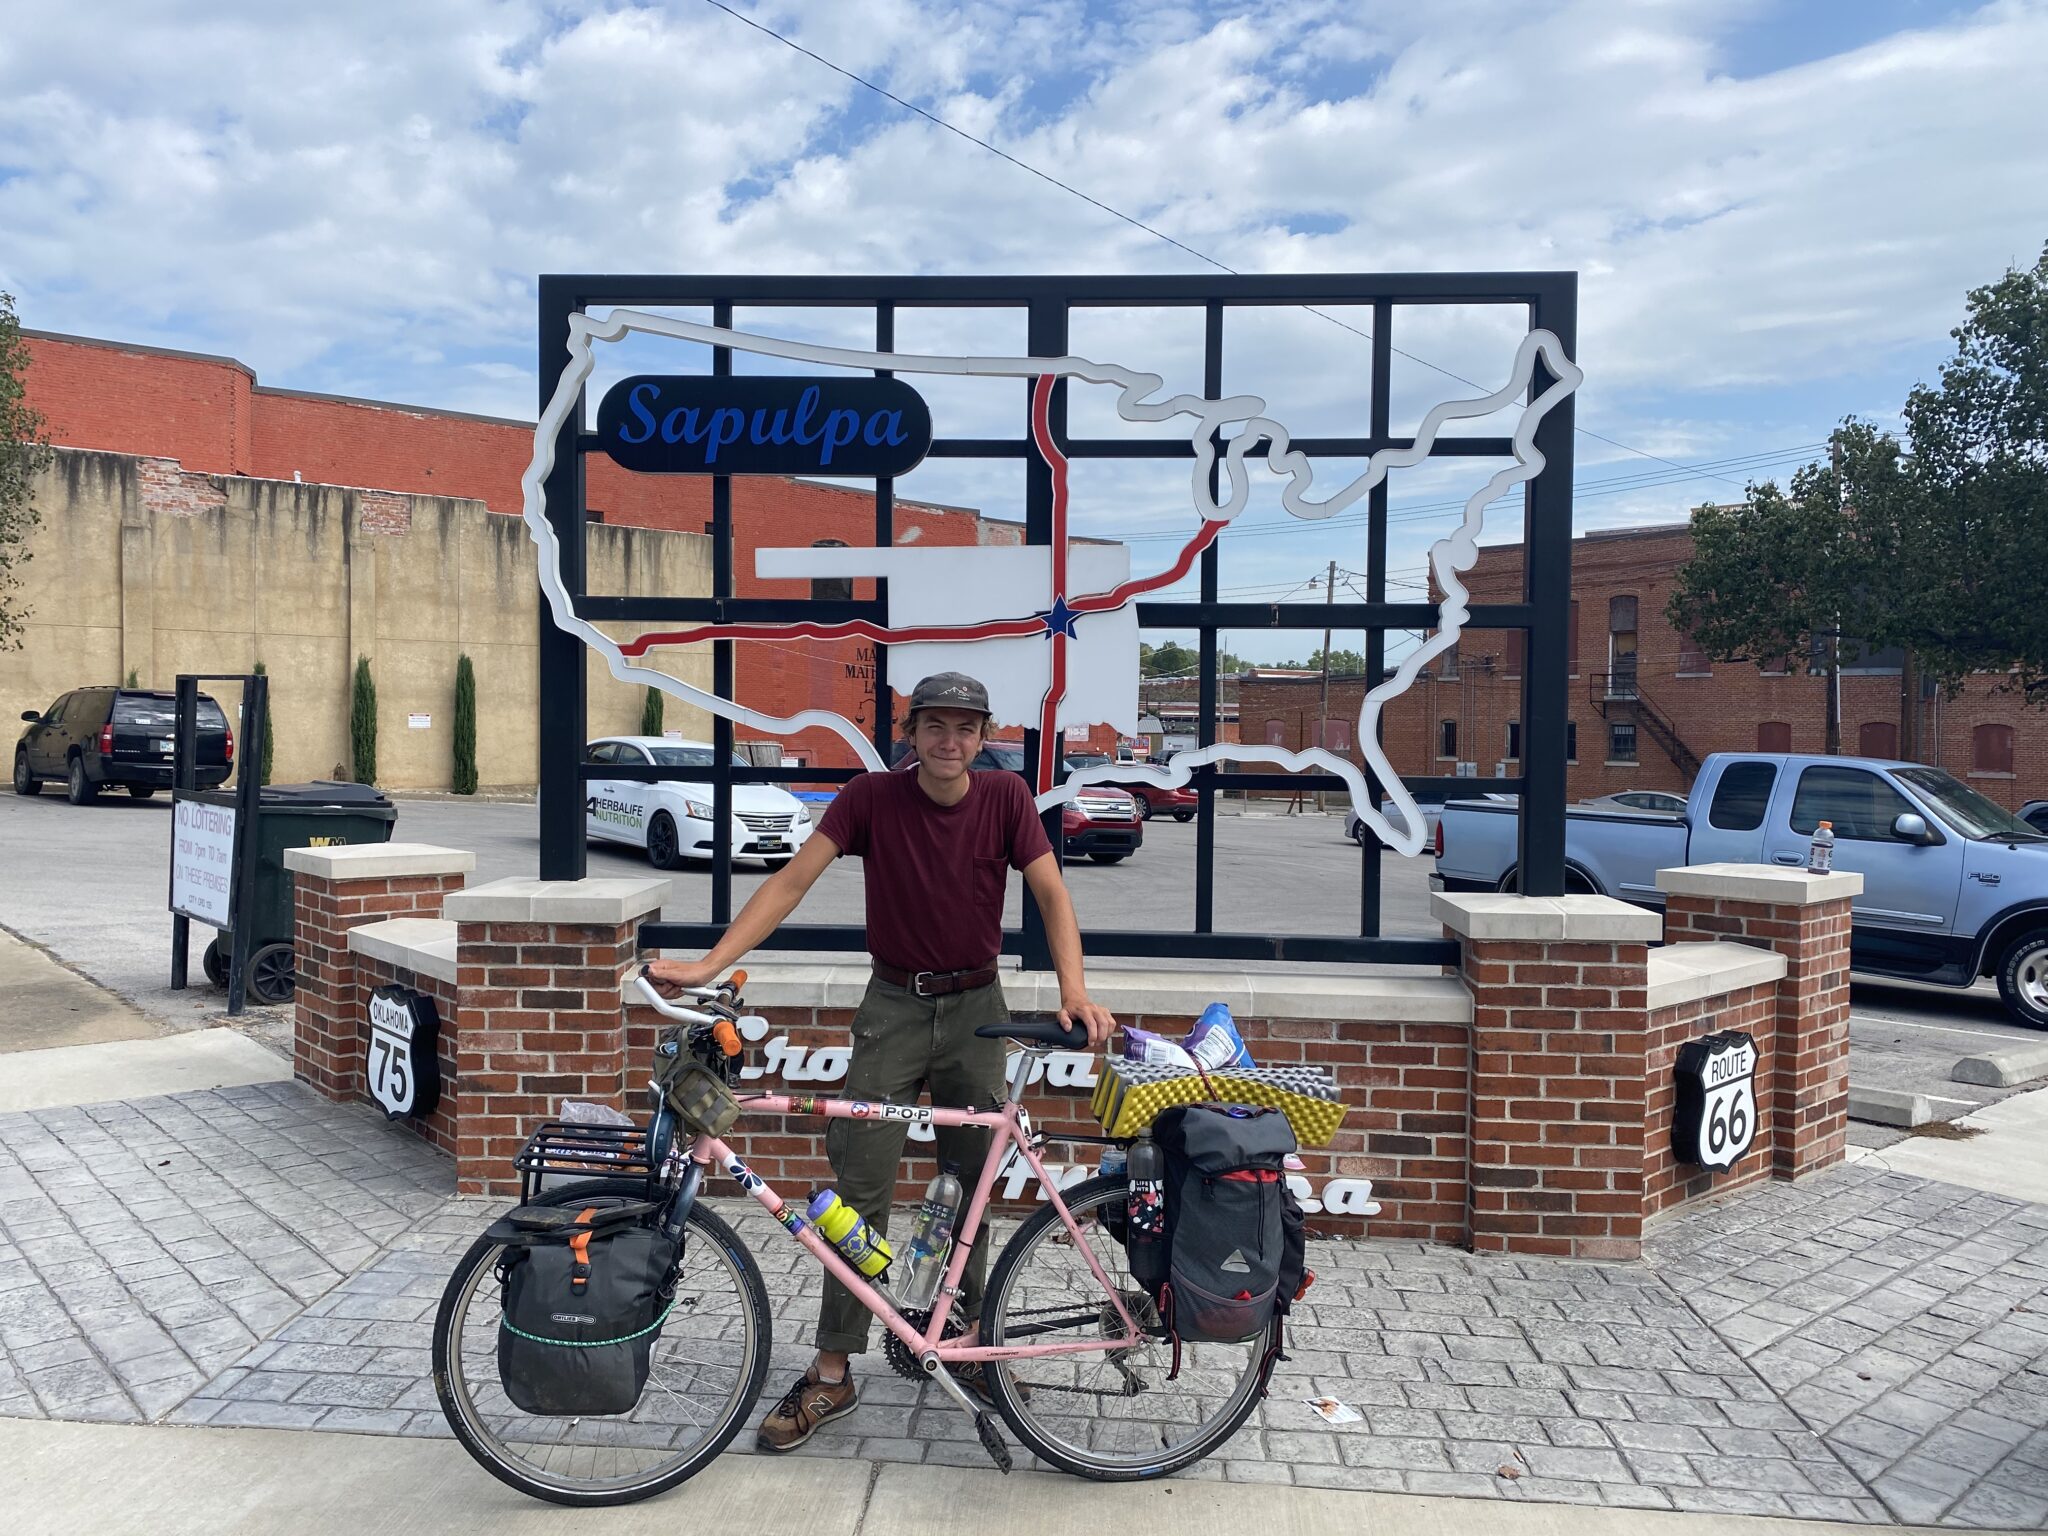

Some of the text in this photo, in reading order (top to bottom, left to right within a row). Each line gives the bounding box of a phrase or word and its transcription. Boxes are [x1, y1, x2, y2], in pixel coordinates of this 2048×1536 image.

[618, 383, 909, 466] Sapulpa
[178, 805, 232, 837] NO LOITERING
[596, 797, 644, 817] HERBALIFE
[596, 810, 643, 829] NUTRITION
[178, 838, 193, 855] FROM
[373, 1002, 409, 1034] OKLAHOMA
[375, 1037, 407, 1103] 75
[1711, 1050, 1747, 1083] ROUTE
[1708, 1088, 1747, 1155] 66
[923, 1201, 950, 1213] LIFE
